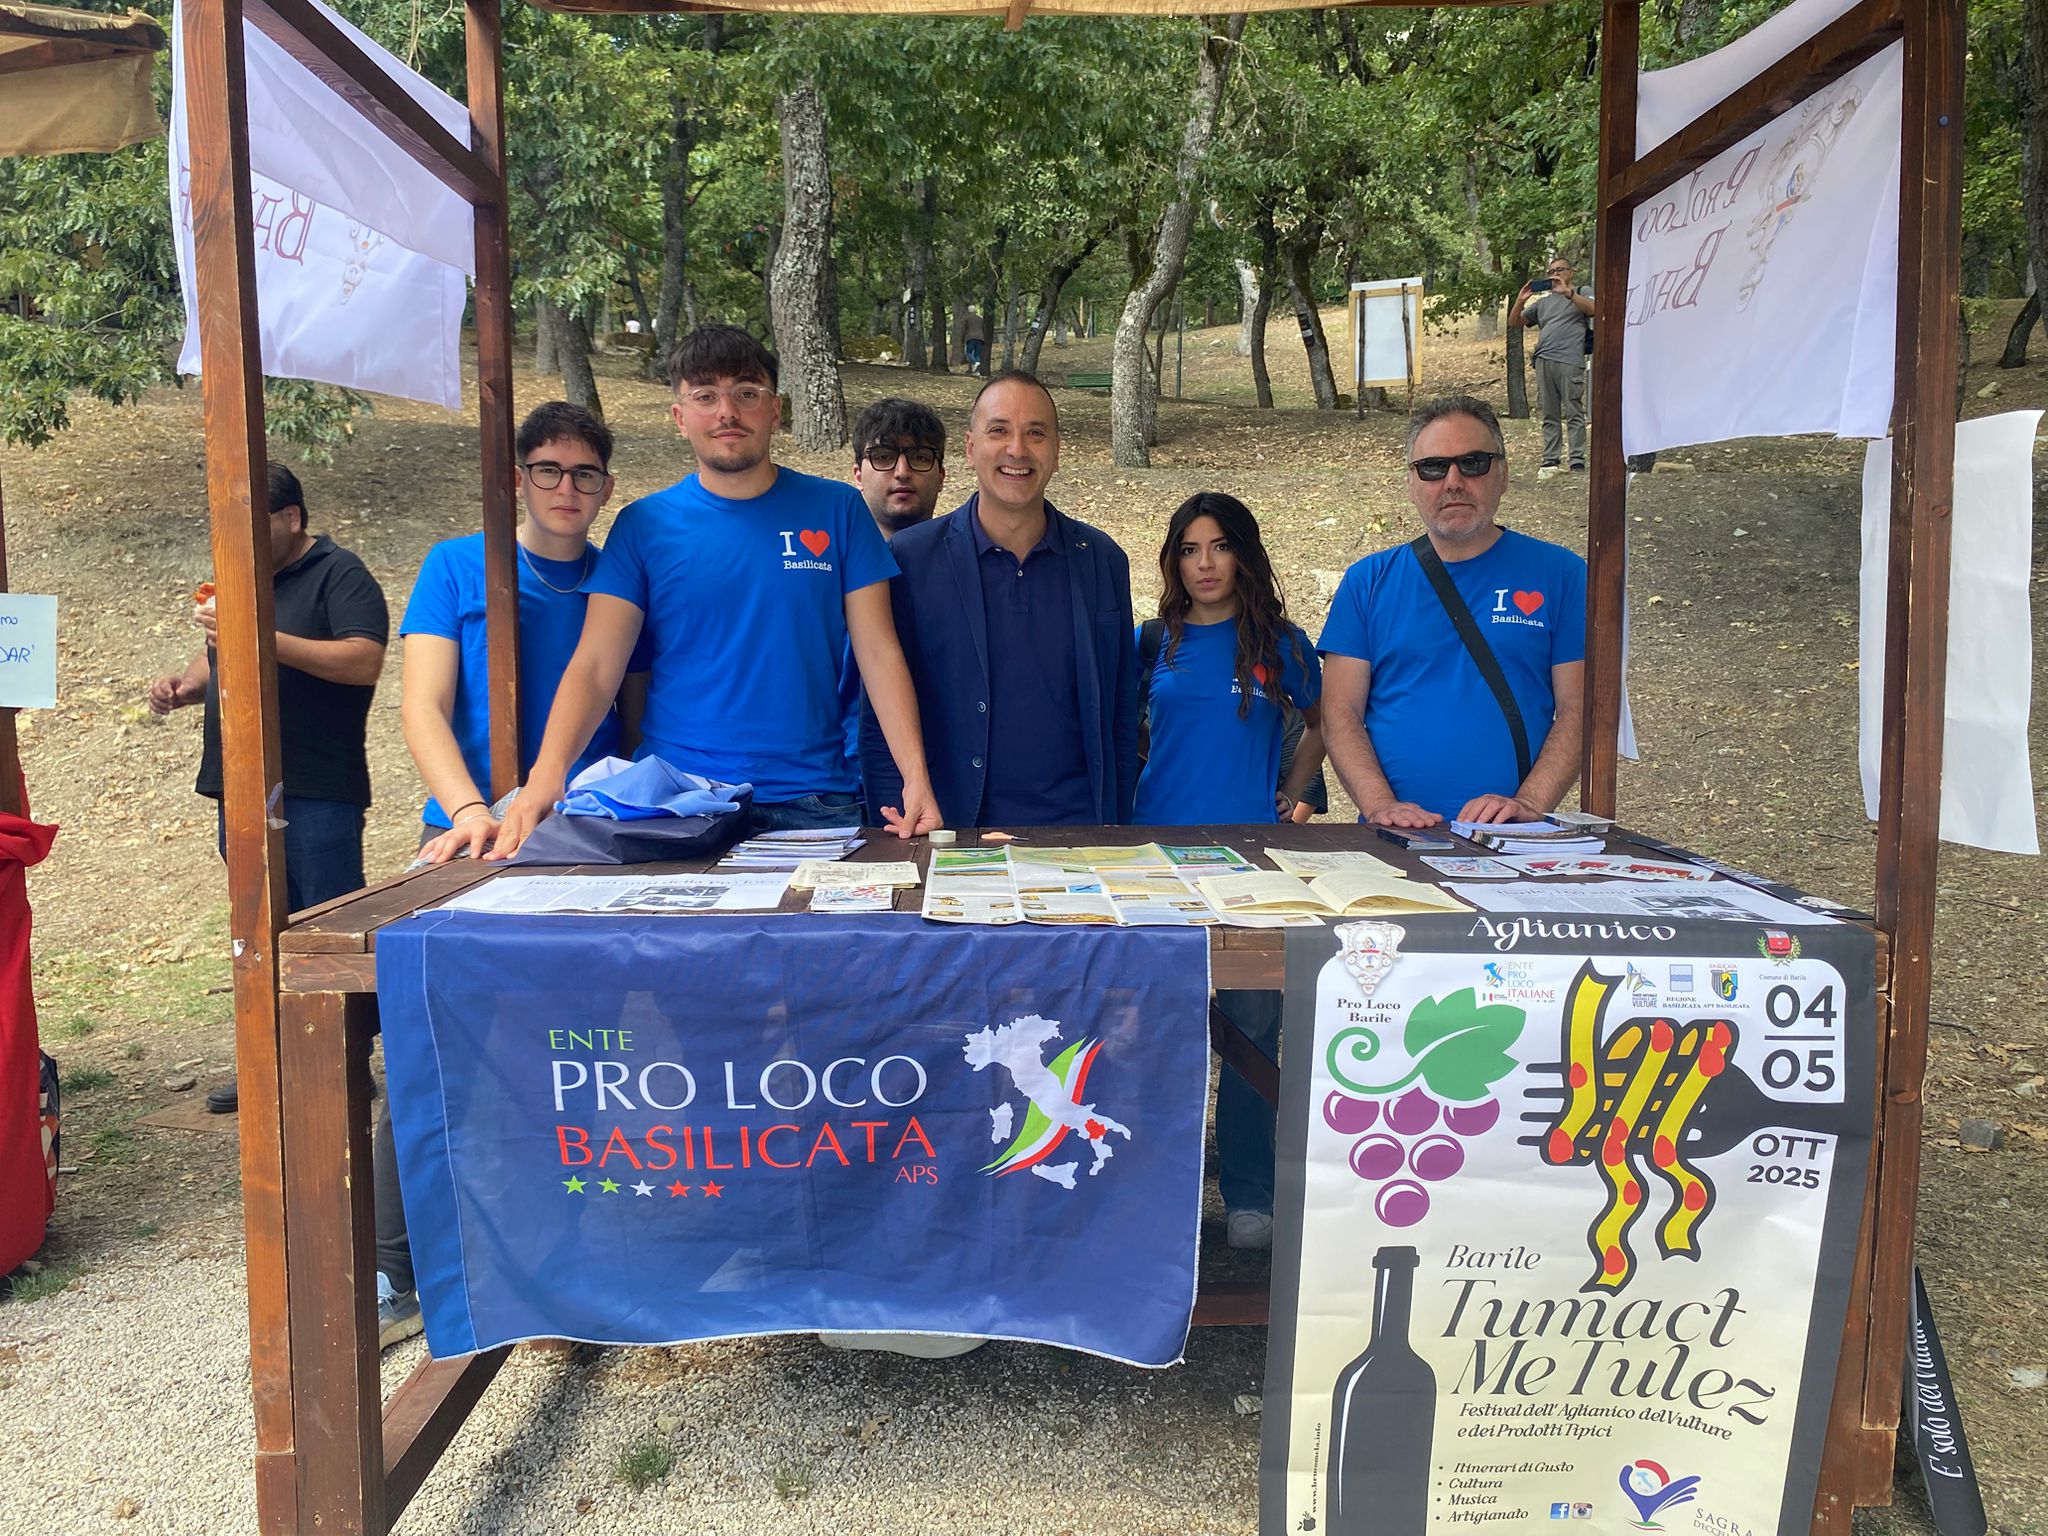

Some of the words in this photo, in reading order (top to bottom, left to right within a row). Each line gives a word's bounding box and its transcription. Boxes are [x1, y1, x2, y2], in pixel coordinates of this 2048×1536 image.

[779, 531, 797, 556] I
[783, 559, 833, 572] Basilicata
[1492, 588, 1509, 612] I
[1491, 614, 1545, 628] Basilicata
[1467, 916, 1677, 951] Aglianico
[1508, 961, 1535, 970] ENTE
[1508, 970, 1527, 979] PRO
[1508, 980, 1535, 988] LOCO
[1508, 989, 1556, 999] ITALIANE
[1336, 998, 1362, 1009] Pro
[1366, 999, 1401, 1010] Loco
[1765, 984, 1837, 1029] 04
[1349, 1012, 1392, 1023] Barile
[548, 1028, 635, 1052] ENTE
[1761, 1048, 1836, 1093] 05
[551, 1060, 697, 1111] PRO
[724, 1055, 928, 1110] LOCO
[555, 1115, 937, 1170] BASILICATA
[1752, 1133, 1827, 1160] OTT
[894, 1165, 939, 1185] APS
[1746, 1164, 1820, 1189] 2025
[1446, 1244, 1542, 1270] Barile
[1440, 1279, 1748, 1348] Tumact
[1450, 1339, 1557, 1396] Me
[1567, 1339, 1777, 1426] Tulez
[1917, 1382, 1946, 1413] del
[1457, 1426, 1467, 1438] e
[1468, 1424, 1496, 1438] dei
[1496, 1423, 1564, 1438] Prodotti
[1564, 1423, 1613, 1440] Tipici
[1459, 1402, 1523, 1417] Festival
[1557, 1402, 1636, 1421] Aglianico
[1639, 1407, 1667, 1423] del
[1667, 1410, 1733, 1441] Vulture
[1920, 1416, 1958, 1455] solo
[1454, 1462, 1517, 1473] Itinerari
[1518, 1462, 1534, 1473] di
[1534, 1461, 1574, 1473] Gusto
[1448, 1477, 1503, 1489] Cultura
[1448, 1494, 1498, 1506] Musica
[1448, 1508, 1529, 1525] Artigianato
